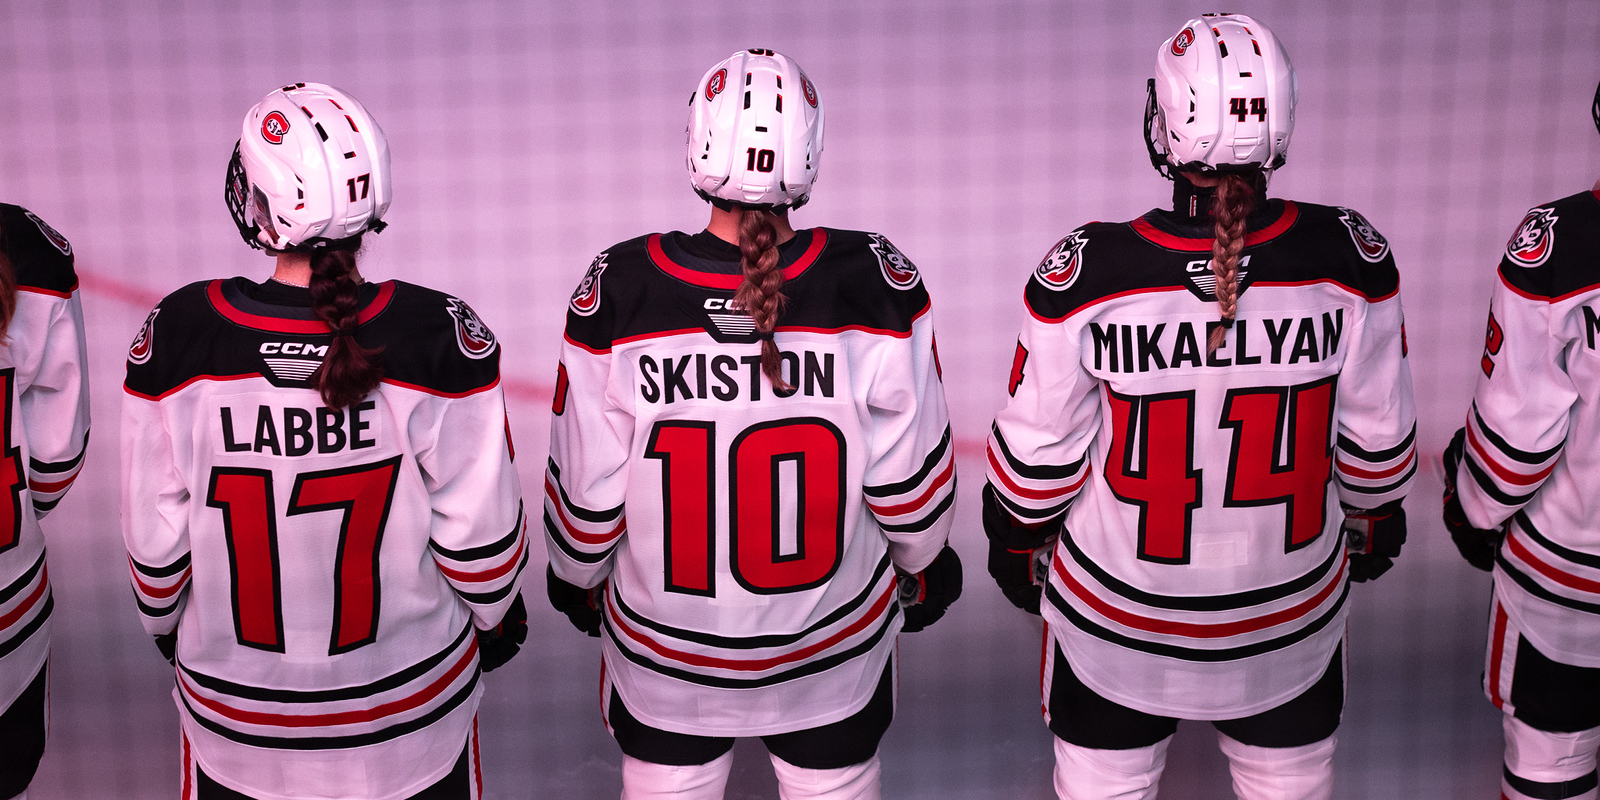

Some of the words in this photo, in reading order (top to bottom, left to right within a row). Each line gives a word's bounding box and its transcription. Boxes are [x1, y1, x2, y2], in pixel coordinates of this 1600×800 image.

[1229, 97, 1267, 122] 44
[346, 172, 370, 203] 17
[746, 147, 775, 173] 10
[258, 342, 329, 357] CCM
[1089, 308, 1344, 373] MIKAELYAN
[639, 351, 835, 404] SKISTON
[219, 400, 376, 457] LABBE
[1103, 373, 1340, 565] 44
[643, 416, 847, 598] 10
[205, 454, 404, 656] 17
